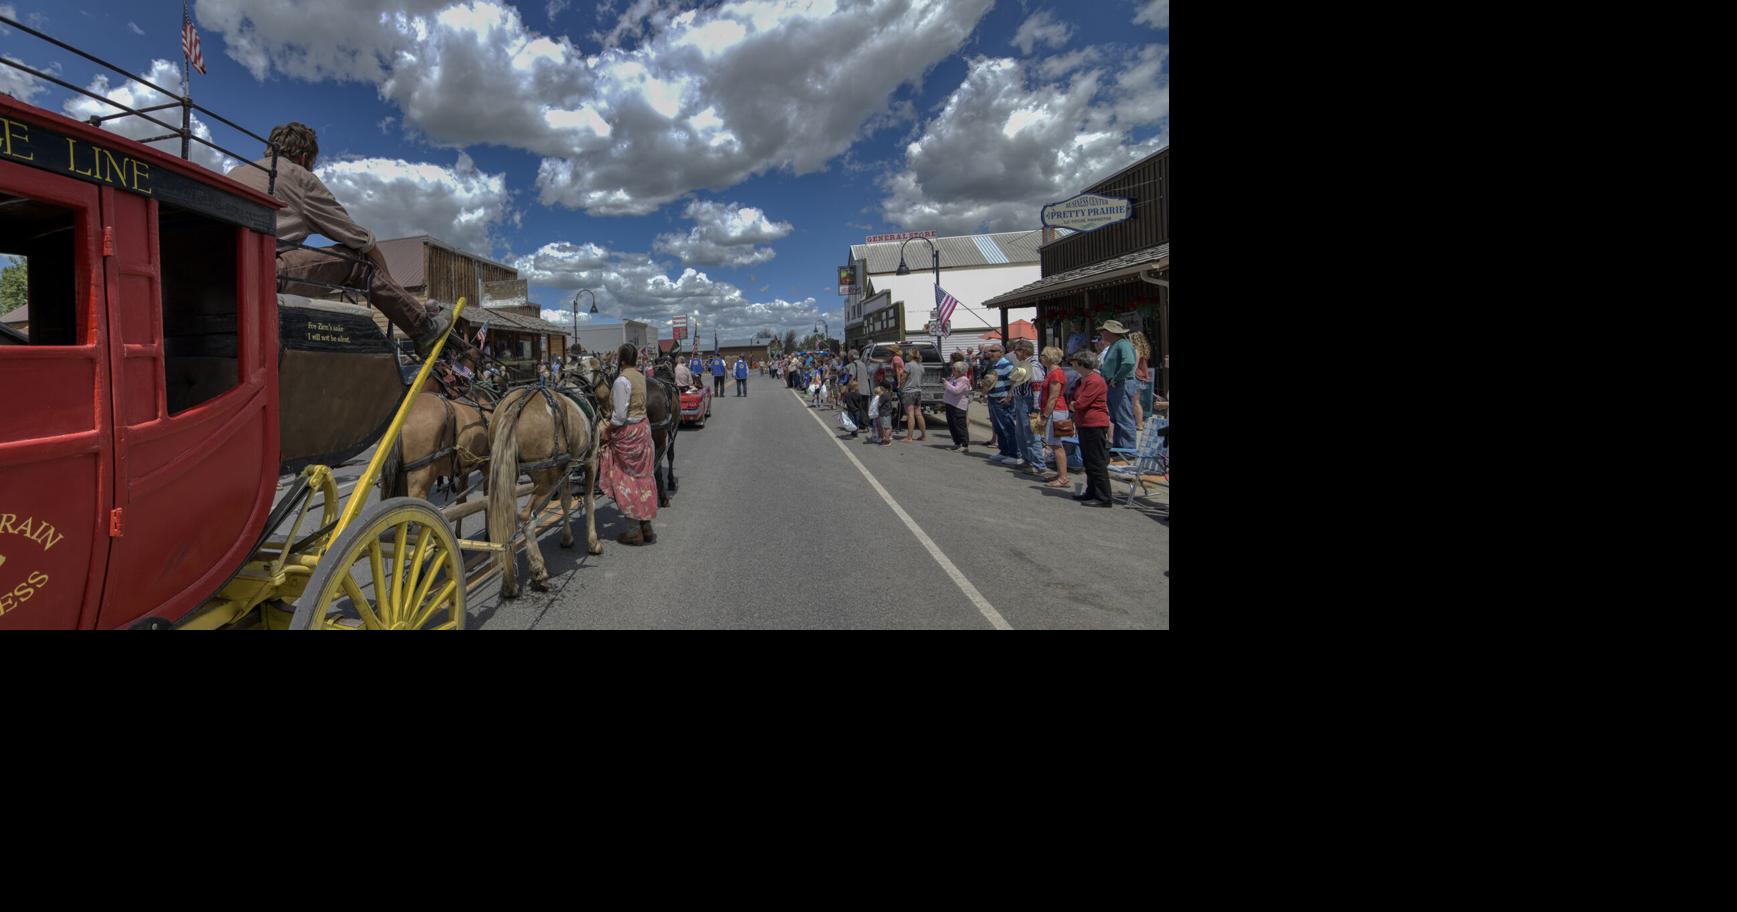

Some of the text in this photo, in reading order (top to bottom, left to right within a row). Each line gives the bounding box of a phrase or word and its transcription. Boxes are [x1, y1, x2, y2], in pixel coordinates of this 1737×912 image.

[0, 117, 152, 195] E LINE
[1089, 197, 1109, 206] CENTER
[1051, 206, 1125, 220] PRETTY PRAIRIE
[867, 231, 936, 243] GENERAL STORE
[312, 333, 321, 341] will
